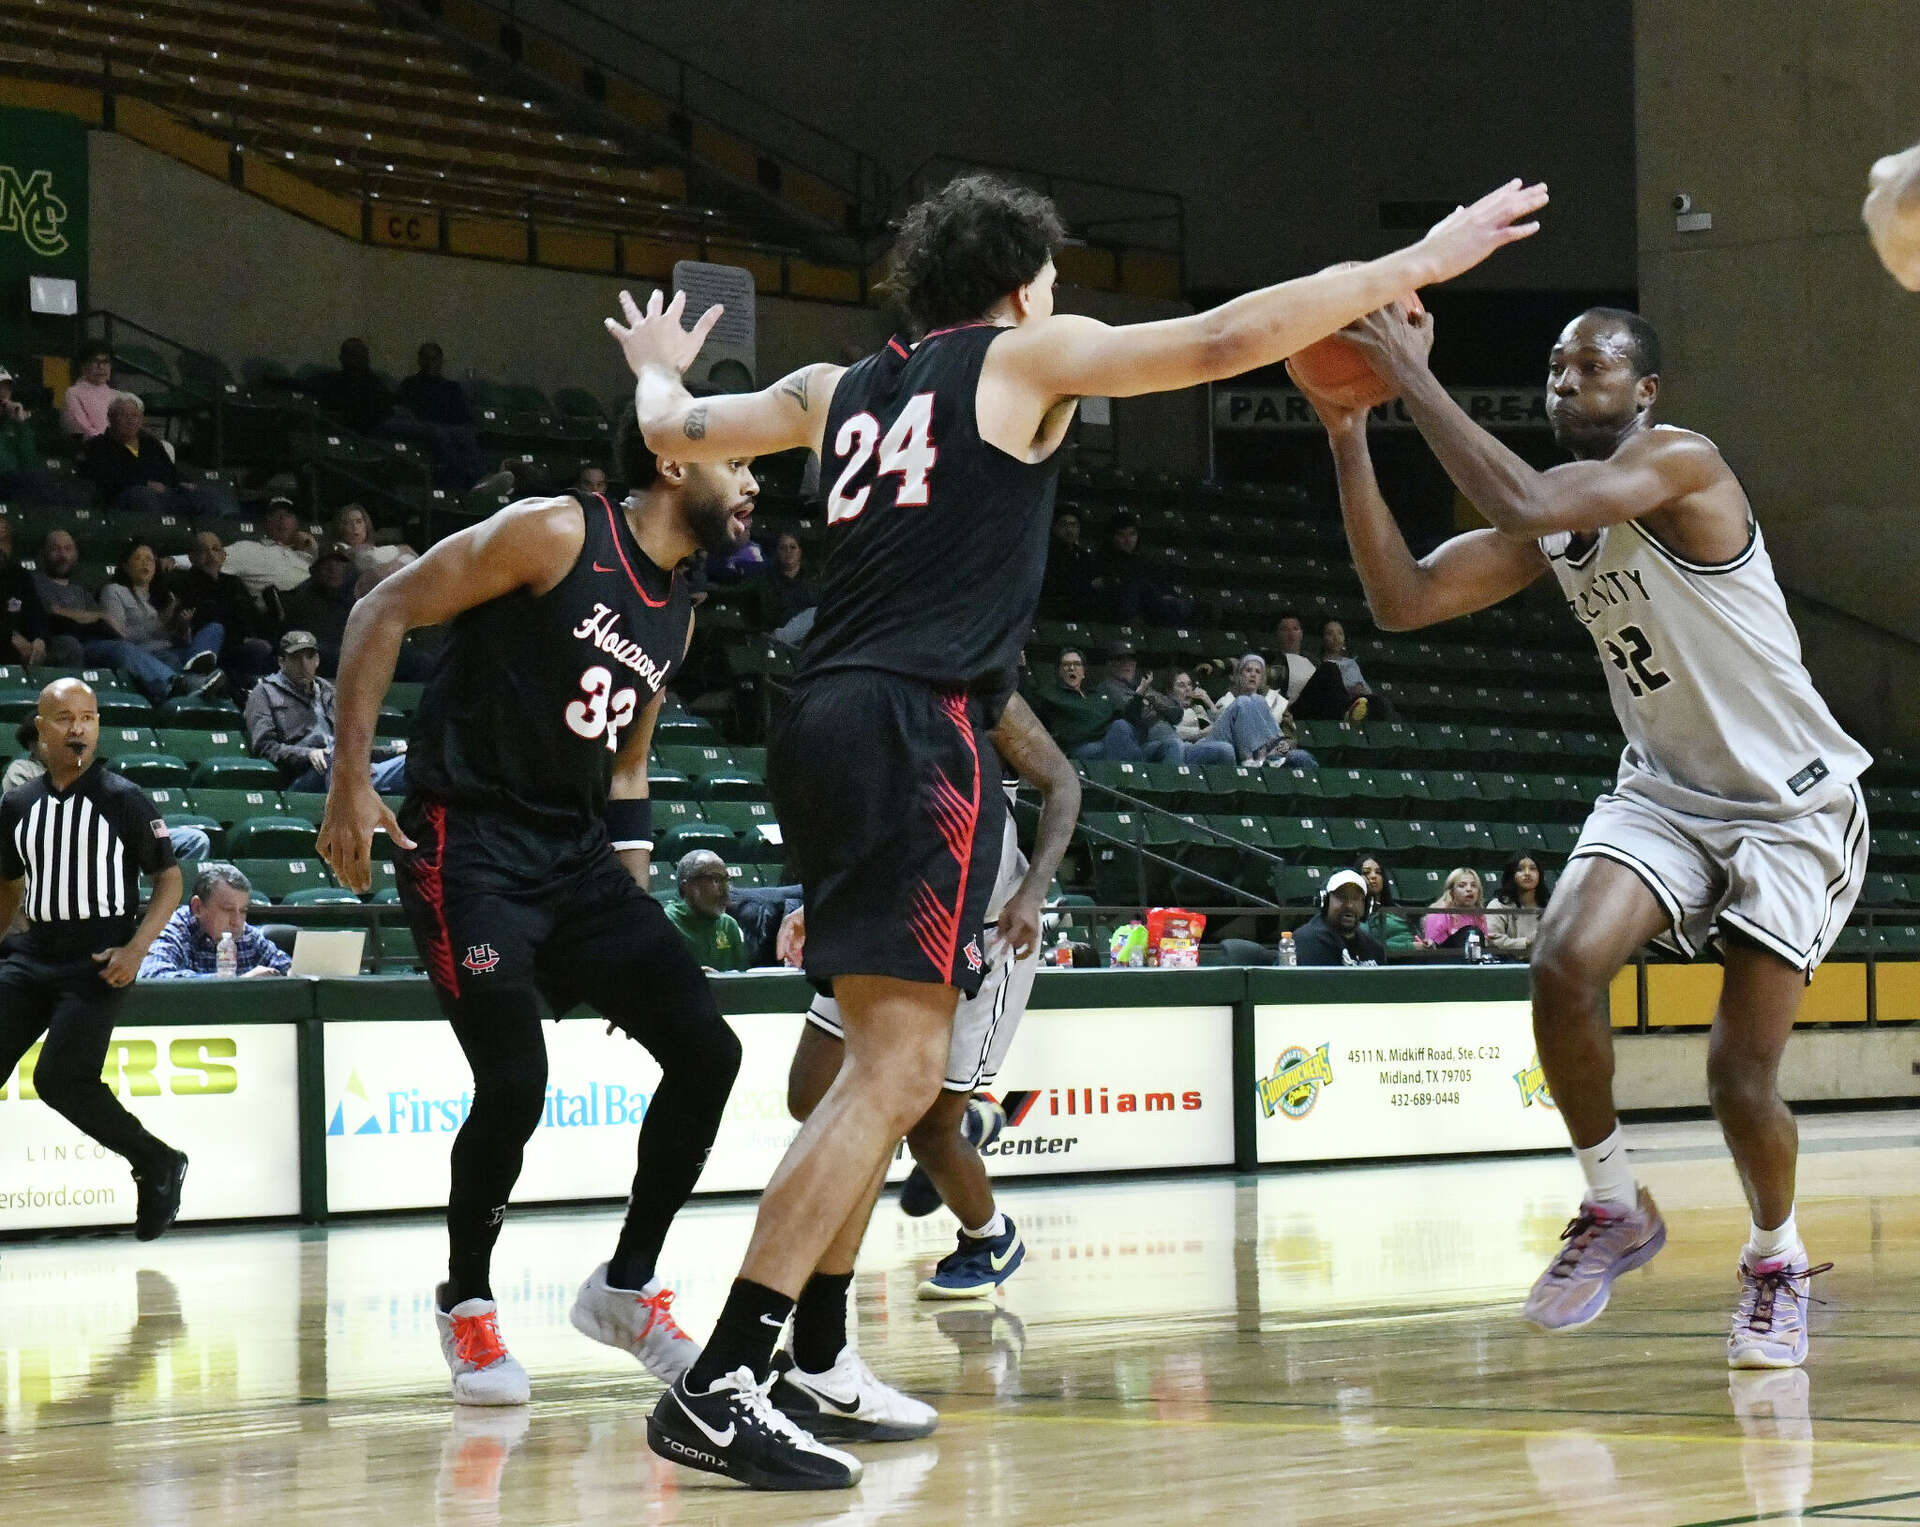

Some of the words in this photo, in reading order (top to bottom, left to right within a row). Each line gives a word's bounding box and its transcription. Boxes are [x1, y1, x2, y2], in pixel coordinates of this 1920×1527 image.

[827, 391, 939, 528] 24
[572, 602, 671, 692] Howard
[565, 665, 637, 754] 32
[1348, 1050, 1373, 1063] 4511
[1375, 1049, 1387, 1062] N.
[1389, 1048, 1425, 1062] Midkiff
[1427, 1047, 1455, 1061] Road,
[1457, 1047, 1476, 1060] Ste.
[1478, 1046, 1500, 1059] C-22
[1379, 1071, 1424, 1085] Midland,
[1426, 1070, 1439, 1083] TX
[1441, 1070, 1472, 1083] 79705
[387, 1088, 472, 1134] First
[604, 1084, 655, 1126] Ba
[1390, 1092, 1460, 1106] 432-689-0448
[27, 1143, 121, 1161] LINCO
